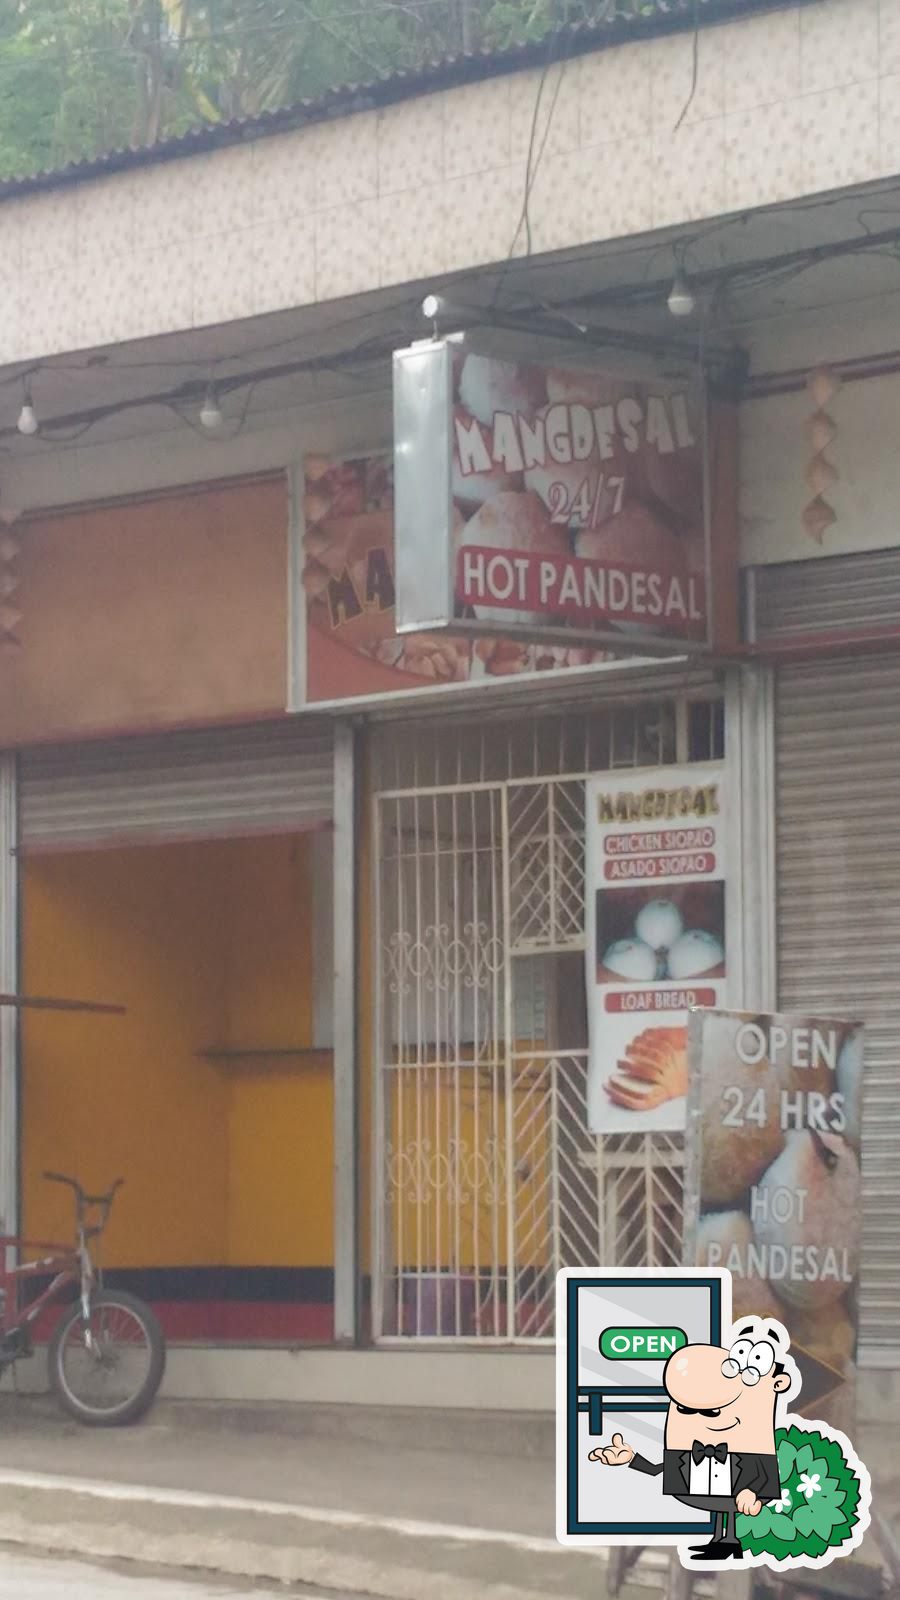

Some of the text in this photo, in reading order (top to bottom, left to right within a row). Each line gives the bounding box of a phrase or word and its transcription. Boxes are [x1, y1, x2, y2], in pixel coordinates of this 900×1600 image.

[454, 394, 695, 476] MANGDESAL
[549, 473, 625, 529] 24/7
[463, 552, 704, 619] HOT PANDESAL
[606, 830, 713, 852] CHICKEN SIOPAO
[610, 856, 706, 877] ASADO SIOPAO
[621, 991, 697, 1009] LOAF BREAD
[735, 1023, 837, 1069] OPEN
[722, 1086, 848, 1132] 24 HRS
[750, 1186, 808, 1223] HOT
[707, 1242, 853, 1282] PANDESAL
